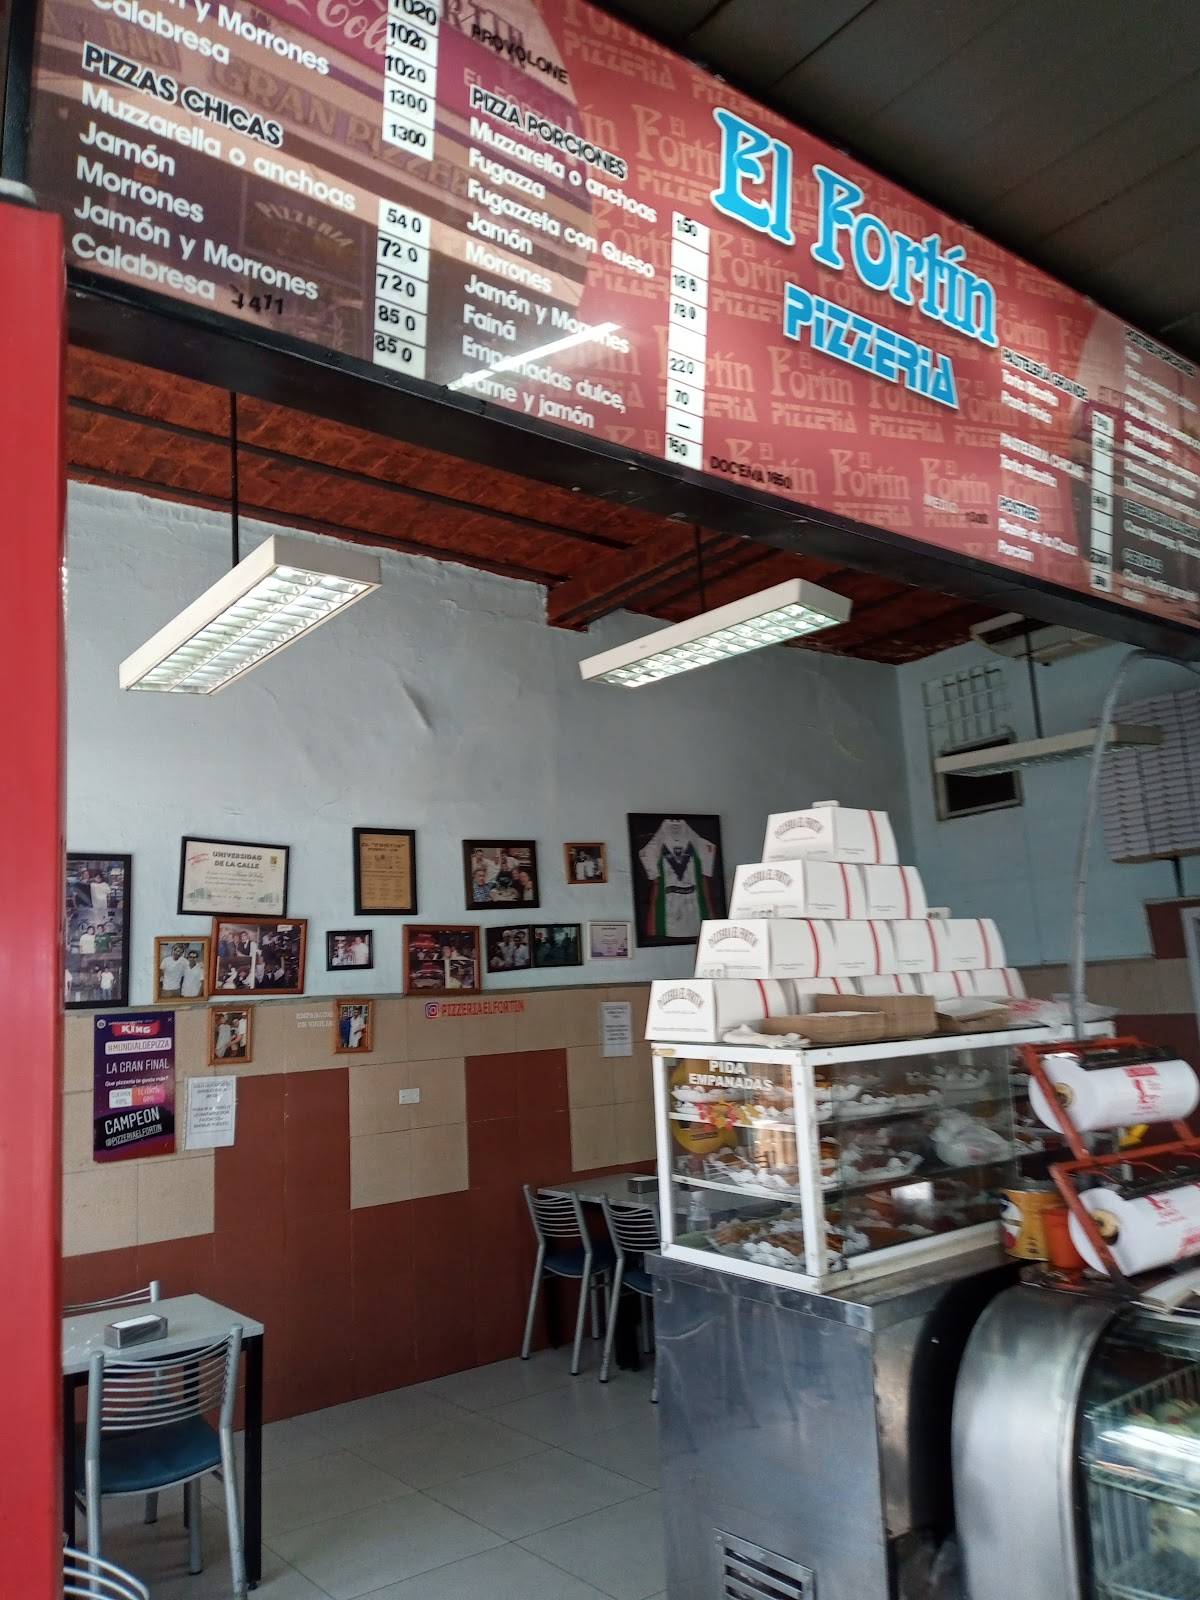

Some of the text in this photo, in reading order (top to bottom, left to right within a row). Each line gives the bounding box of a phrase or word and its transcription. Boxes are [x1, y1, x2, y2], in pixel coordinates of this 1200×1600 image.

[393, 0, 437, 26] 1020
[217, 6, 330, 76] Morrones
[389, 22, 427, 52] 1020
[384, 54, 427, 84] 1020
[471, 23, 569, 85] PROVOLONE
[82, 42, 284, 148] PIZZAS CHICAS
[389, 89, 428, 114] 1300
[79, 121, 176, 177] Jamón
[81, 82, 357, 211] Muzzarella o anchoas
[390, 124, 428, 148] 1300
[469, 83, 524, 131] PIZZA
[524, 111, 629, 182] PORCIONES
[468, 147, 546, 200] Fugazza
[469, 116, 565, 180] Muzzarella
[569, 170, 583, 186] o
[585, 178, 658, 223] anchoas
[76, 155, 204, 224] Morrones
[386, 207, 422, 234] 540
[466, 211, 534, 256] Jamón
[467, 177, 656, 279] Fugazzeta con Queso
[709, 105, 796, 246] El
[810, 162, 999, 350] Fortín
[73, 195, 319, 301] Jamón y Morrones
[378, 236, 419, 263] 720
[71, 232, 216, 301] Calabresa
[464, 239, 553, 294] Morrones
[376, 273, 416, 298] 720
[464, 273, 531, 316] Jamón
[534, 302, 548, 326] y
[378, 304, 417, 332] 850
[462, 302, 517, 342] Fainá
[374, 334, 413, 363] 850
[670, 357, 695, 375] 220
[522, 390, 535, 414] y
[537, 395, 596, 430] jamón
[575, 378, 626, 414] dulce,
[675, 389, 690, 405] 70
[710, 455, 765, 484] DOCENA
[212, 851, 263, 861] UNIVERSIDAD
[236, 861, 260, 869] CALLE
[106, 1058, 170, 1075] LA GRAN FINAL
[687, 1073, 774, 1092] EMPANADAS
[709, 1060, 747, 1076] PIDA
[104, 1105, 160, 1136] CAMPEON
